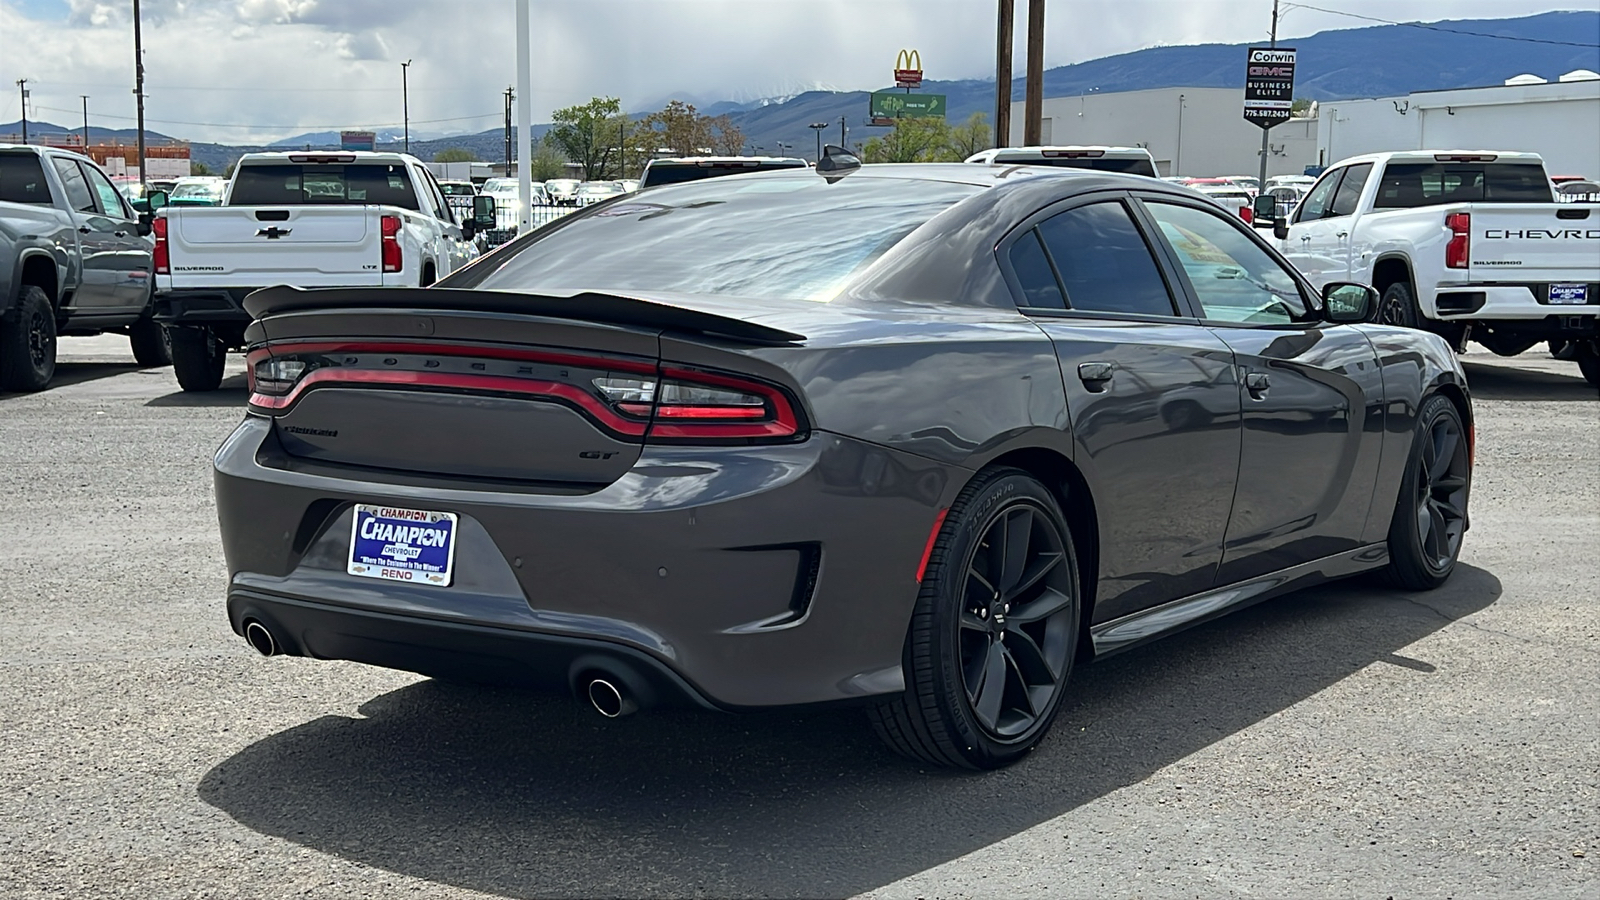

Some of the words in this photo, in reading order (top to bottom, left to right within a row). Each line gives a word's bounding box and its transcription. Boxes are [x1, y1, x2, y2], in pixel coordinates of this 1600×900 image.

[1254, 52, 1294, 62] Corwin
[1249, 67, 1292, 76] GMC
[579, 450, 620, 460] GT
[381, 508, 428, 520] CHAMPION
[360, 517, 448, 547] CHAMPION
[384, 546, 418, 556] CHEVROLET
[378, 557, 386, 565] The
[387, 558, 408, 568] Customer
[414, 562, 422, 570] The
[381, 569, 413, 580] RENO
